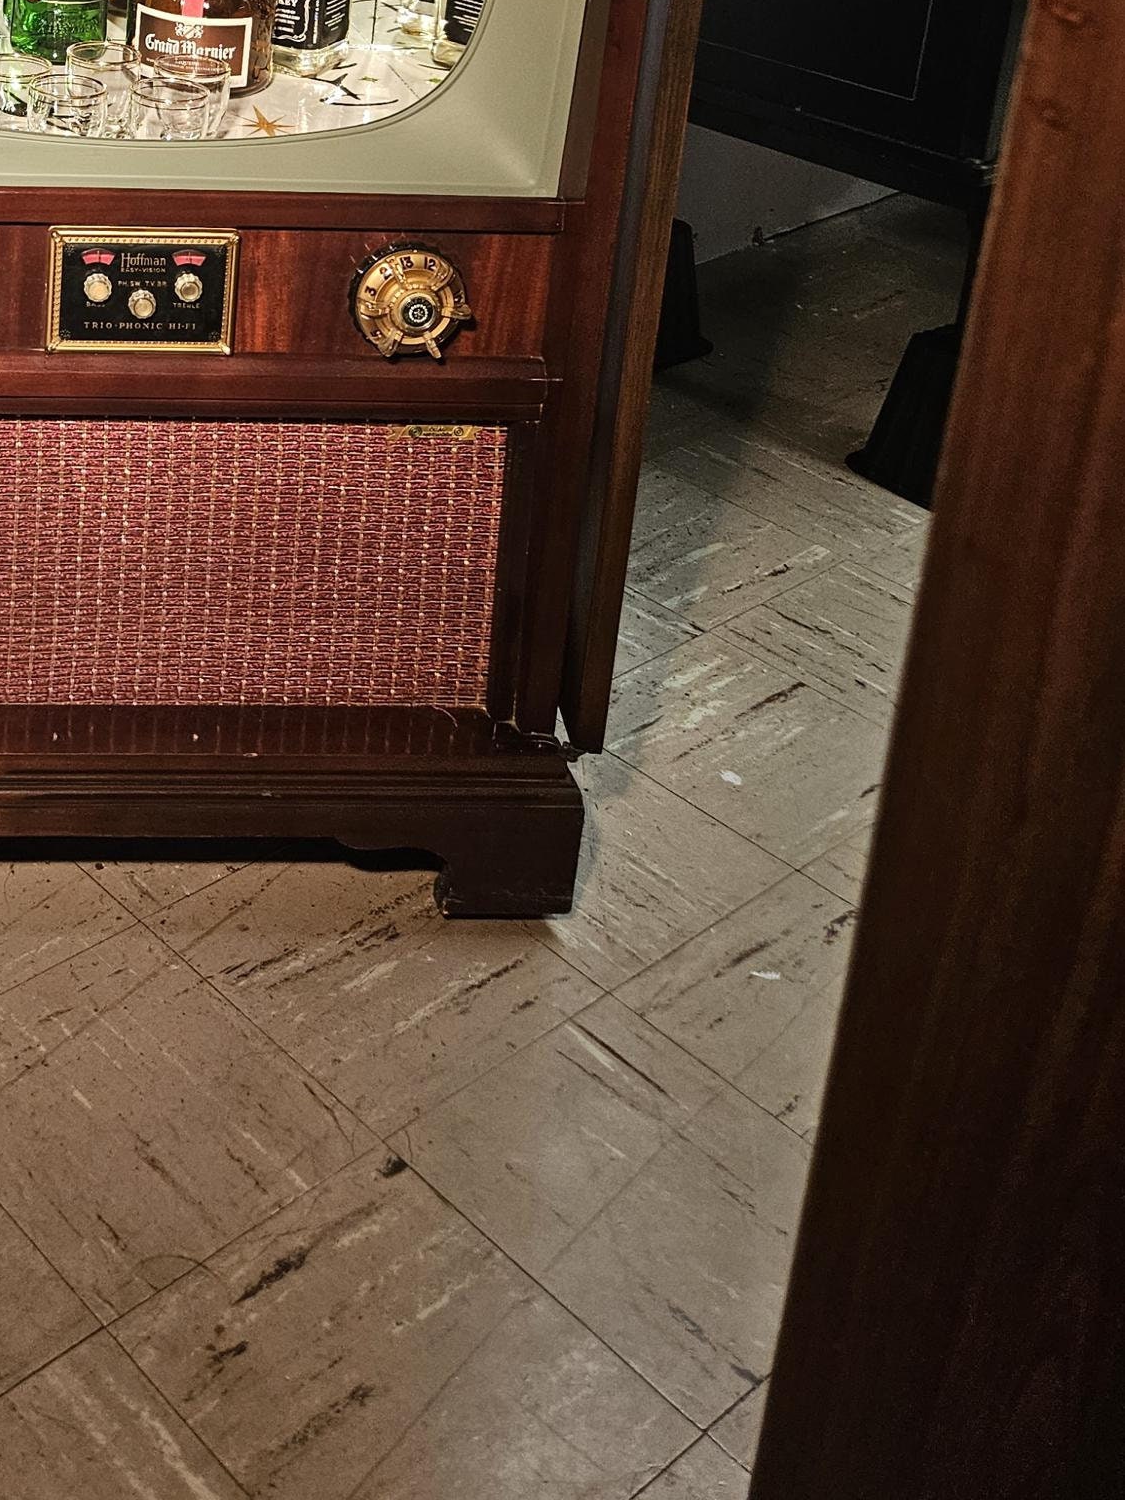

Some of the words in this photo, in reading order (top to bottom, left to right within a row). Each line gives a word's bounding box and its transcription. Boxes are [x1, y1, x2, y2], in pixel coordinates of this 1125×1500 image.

[145, 33, 179, 54] Grand
[180, 40, 237, 60] Marnier
[120, 252, 167, 268] Hoffman
[400, 256, 414, 269] 13
[424, 257, 437, 271] 12
[365, 286, 377, 297] 3
[83, 321, 163, 331] TRIO-PHONIC
[168, 322, 196, 331] HI-FI
